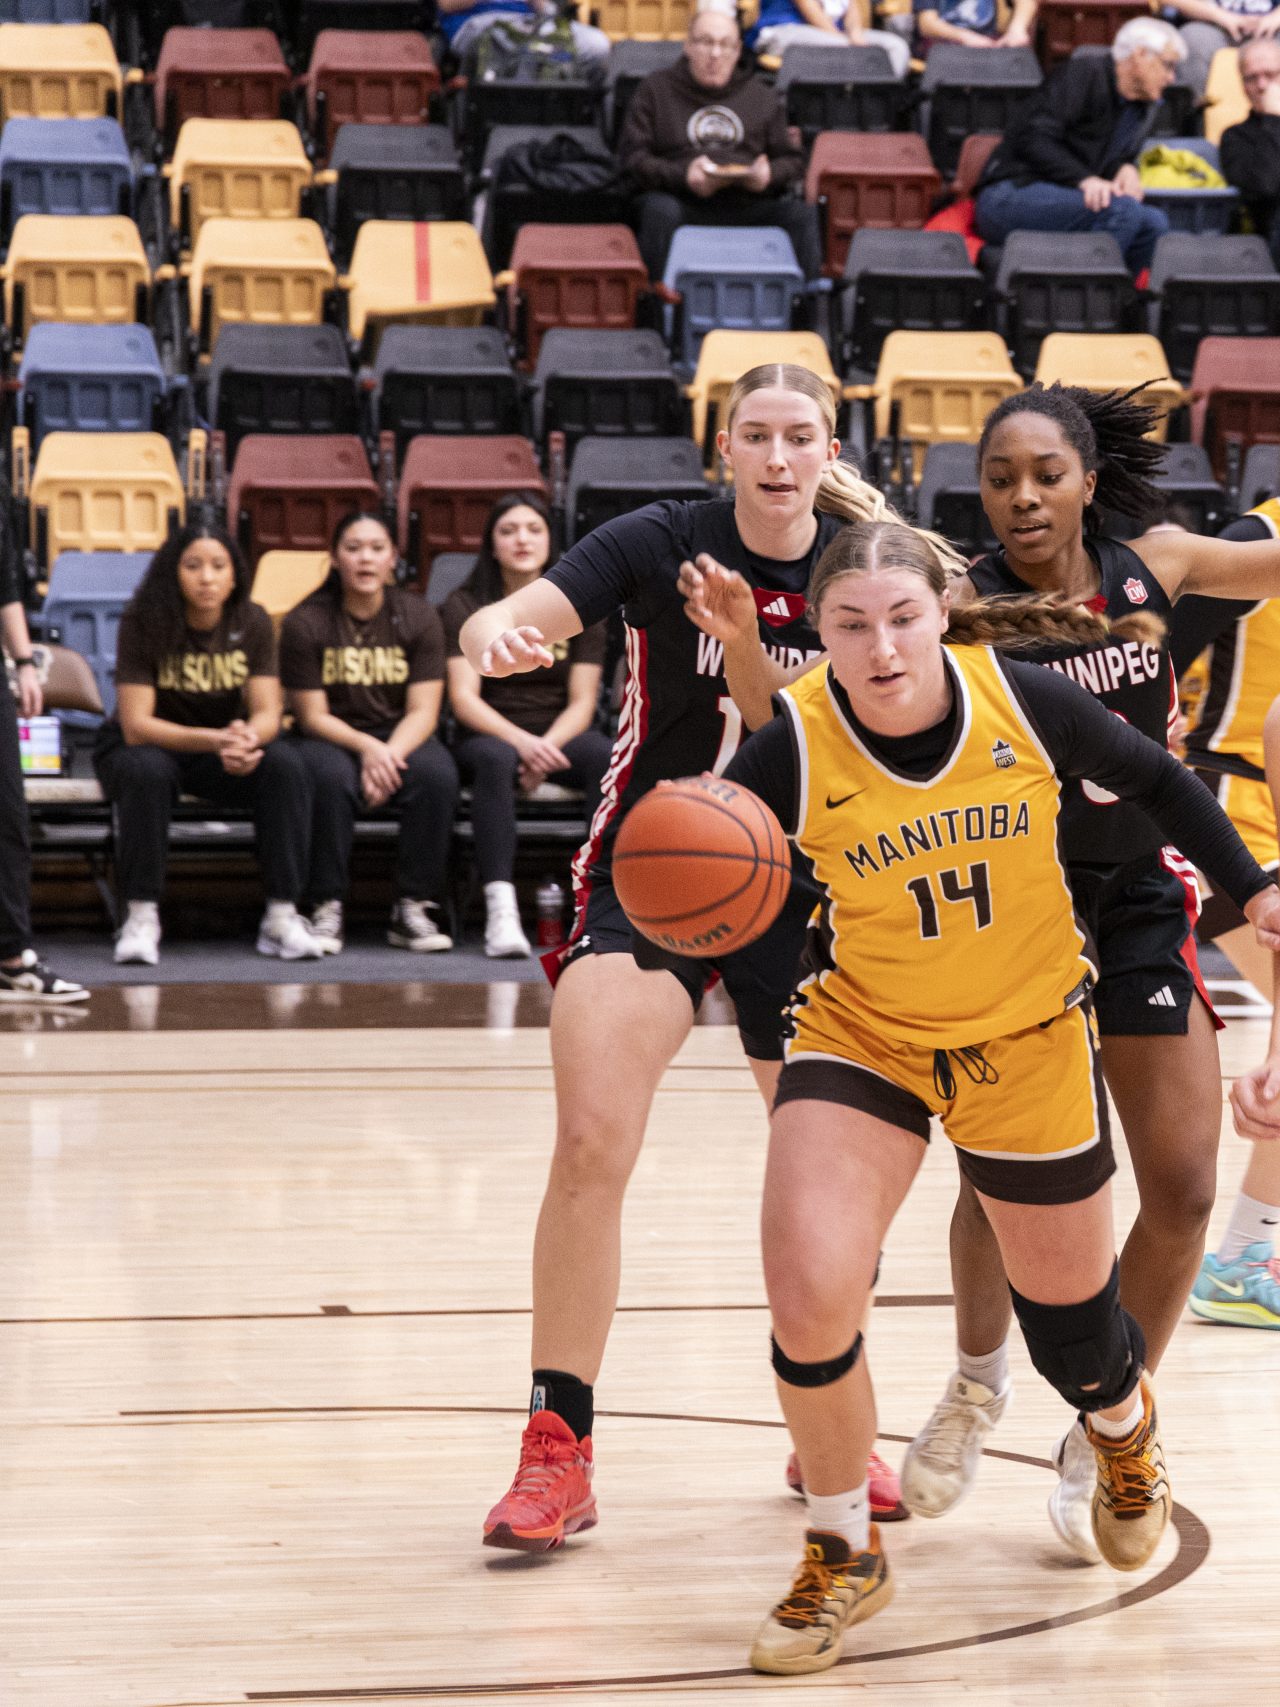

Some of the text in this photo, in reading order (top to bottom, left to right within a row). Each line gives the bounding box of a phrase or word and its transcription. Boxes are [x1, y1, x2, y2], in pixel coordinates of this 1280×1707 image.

[321, 646, 409, 686] BISONS
[843, 800, 1029, 879] MANITOBA
[905, 859, 994, 941] 14
